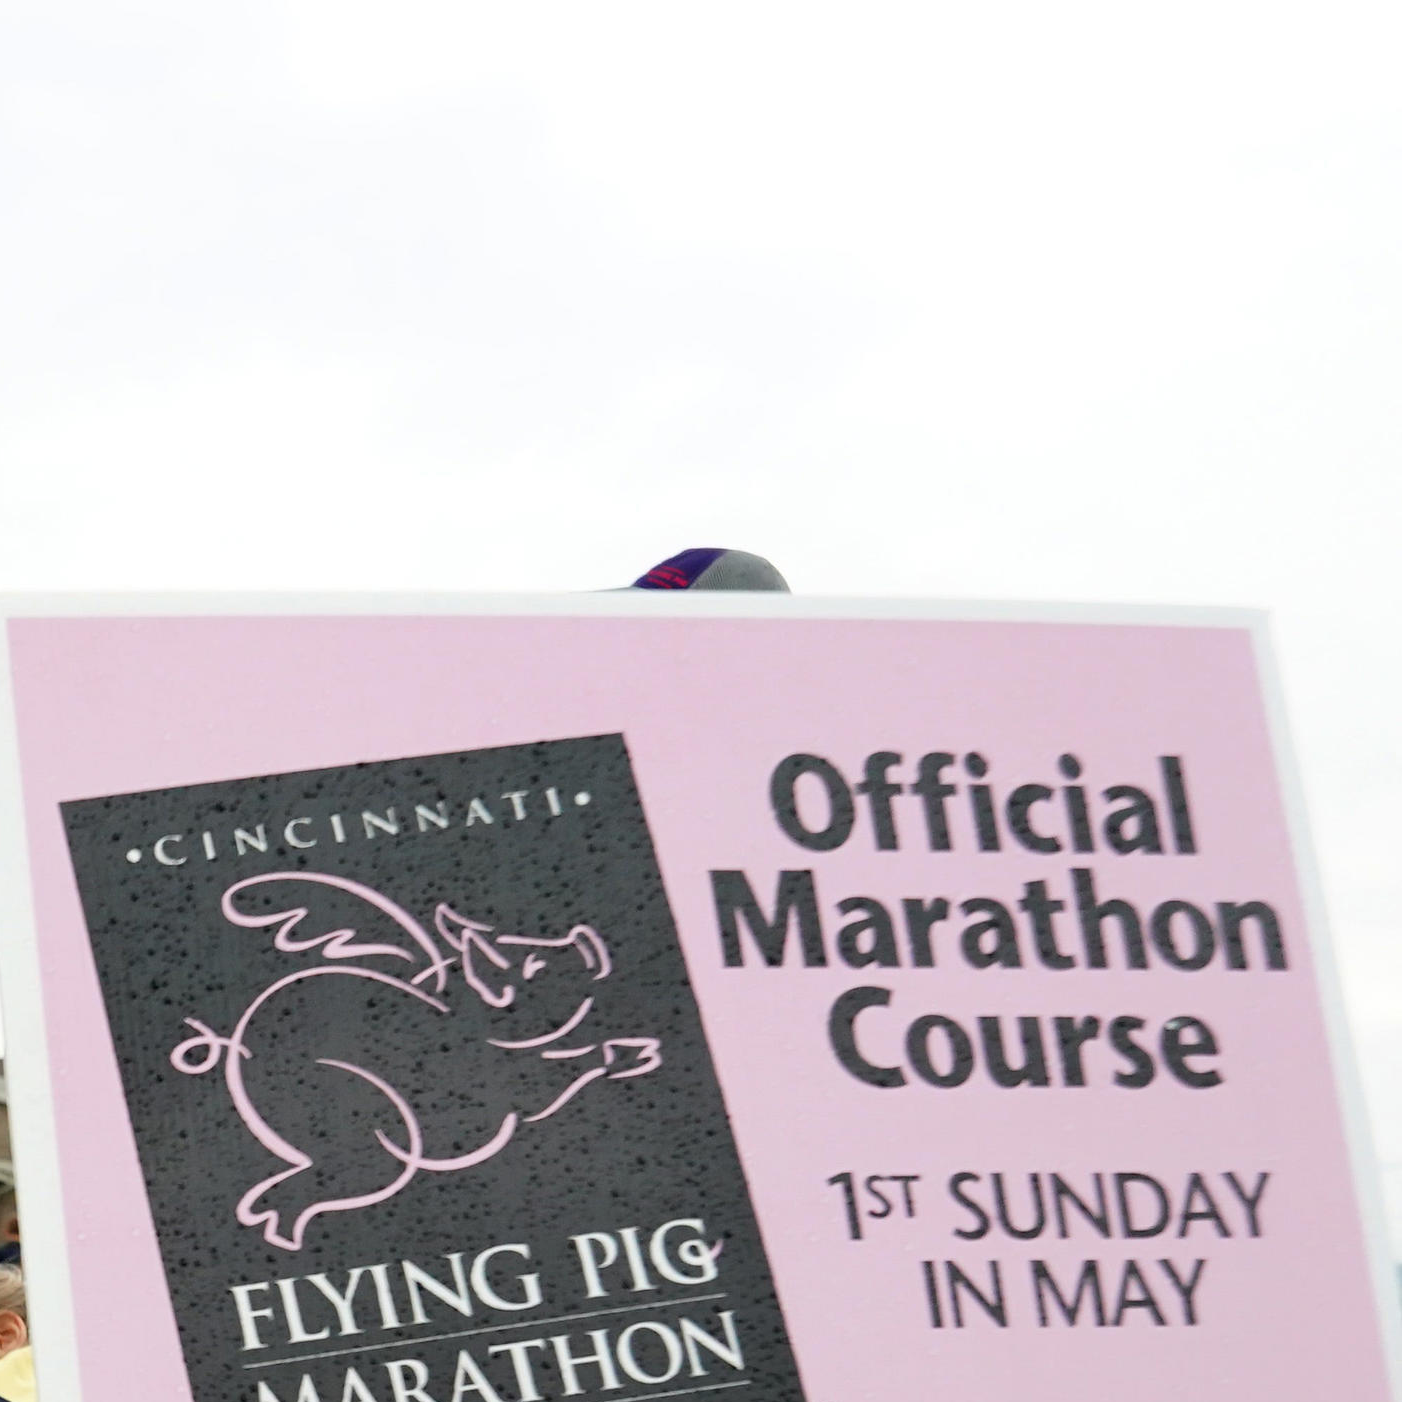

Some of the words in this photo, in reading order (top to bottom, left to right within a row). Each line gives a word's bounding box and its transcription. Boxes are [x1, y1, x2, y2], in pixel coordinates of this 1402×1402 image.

[150, 786, 568, 867] CINCINNATI
[769, 751, 1197, 855] Official
[709, 867, 1288, 971] Marathon
[828, 985, 1223, 1089] Course
[826, 1172, 920, 1241] 1ST
[948, 1170, 1271, 1241] SUNDAY
[228, 1242, 543, 1352] FLYING
[570, 1216, 724, 1300] PIG
[921, 1259, 1008, 1329] IN
[1029, 1258, 1207, 1327] MAY
